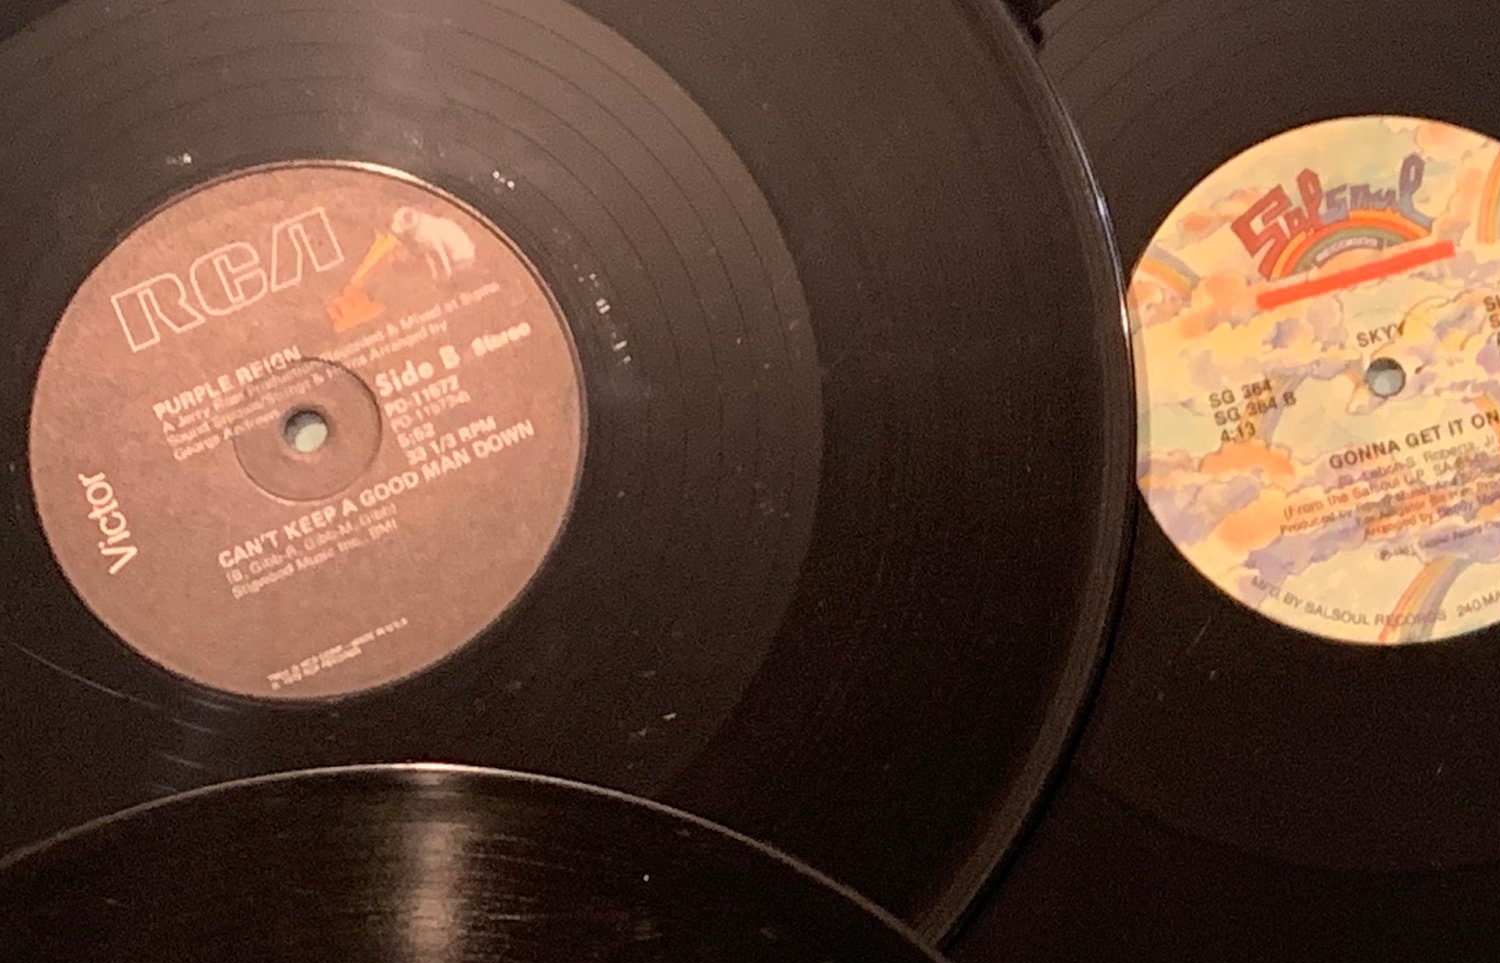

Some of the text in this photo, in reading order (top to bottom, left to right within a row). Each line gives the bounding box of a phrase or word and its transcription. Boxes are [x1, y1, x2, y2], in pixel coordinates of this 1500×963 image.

[110, 206, 344, 353] RCA
[1356, 320, 1405, 348] SKYY
[152, 374, 234, 421] PURPLE
[235, 344, 302, 386] REIGN
[375, 359, 435, 397] Side
[438, 344, 461, 370] B
[1209, 389, 1235, 409] SG
[1214, 407, 1241, 427] SG
[457, 415, 498, 443] RPM
[1329, 439, 1401, 470] GONNA
[1405, 424, 1442, 447] GET
[1449, 418, 1464, 437] IT
[1470, 409, 1500, 430] ON
[217, 418, 536, 569] CAN'T KEEP A GOOD MAN DOWN
[79, 471, 139, 576] Victor
[1304, 601, 1370, 626] SALSOUL
